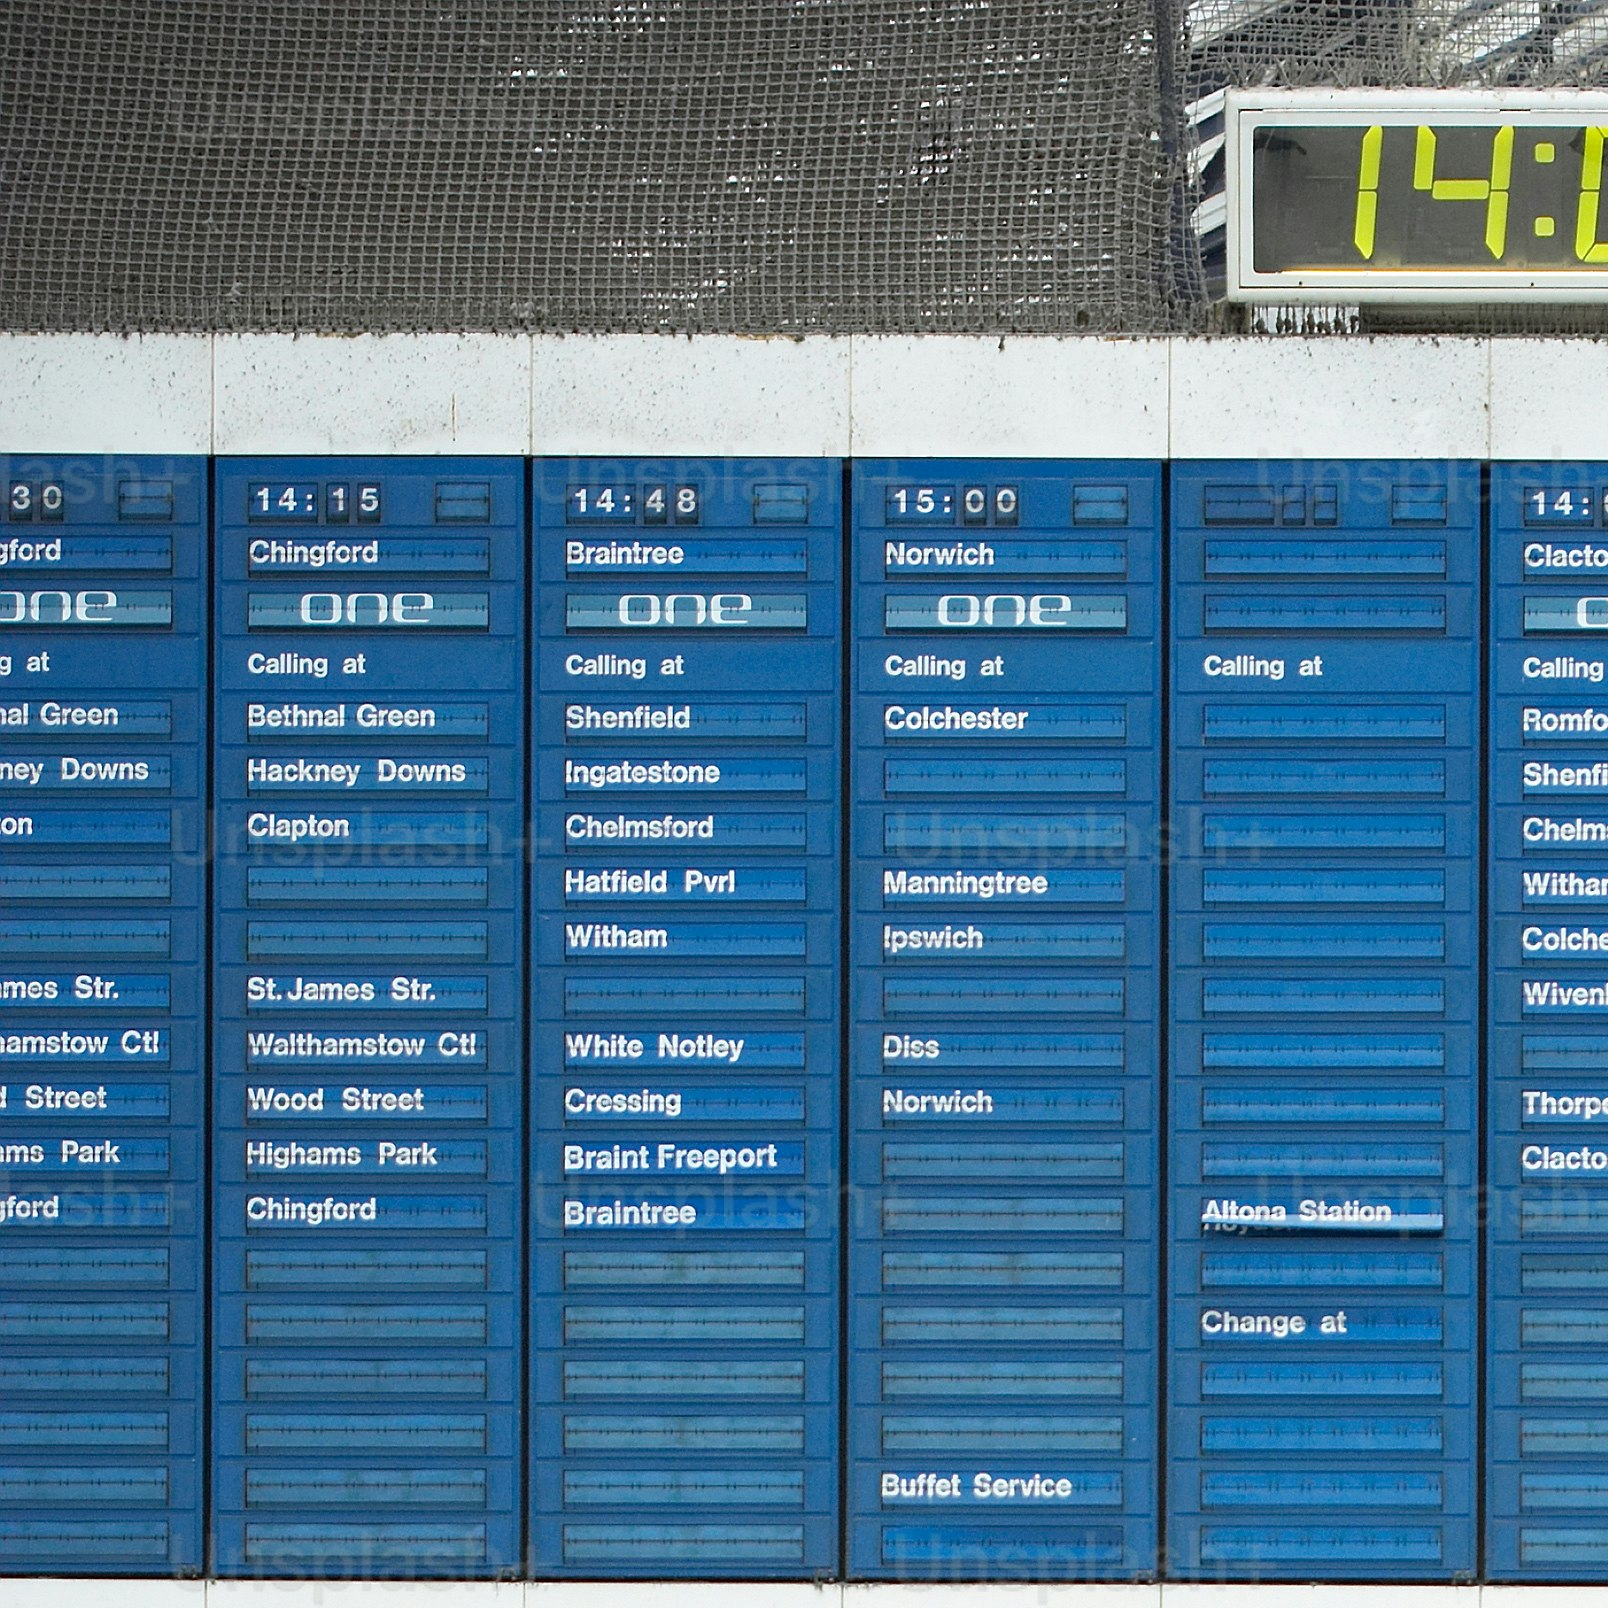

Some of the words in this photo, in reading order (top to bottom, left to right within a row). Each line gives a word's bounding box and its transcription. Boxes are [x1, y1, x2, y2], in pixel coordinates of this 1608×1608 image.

[257, 487, 379, 511] 14:15
[575, 488, 696, 513] 14:48
[894, 489, 1016, 513] 15:00
[249, 540, 378, 567] Chingford
[566, 541, 684, 565] Braintree
[300, 593, 434, 624] one
[247, 653, 328, 678] Calling
[342, 653, 366, 674] at
[248, 704, 345, 727] Bethnal
[356, 703, 435, 727] Green
[248, 758, 361, 787] Hackney
[378, 759, 466, 782] Downs
[565, 760, 720, 788] Ingatestone
[247, 813, 349, 842] Clapton
[565, 814, 714, 838] Chelmsford
[391, 976, 436, 1001] Str.
[248, 1033, 426, 1056] Walthamstow
[438, 1032, 476, 1056] Ctl
[565, 1034, 644, 1058] White
[658, 1034, 744, 1062] Notley
[883, 1035, 940, 1058] Diss
[247, 1142, 361, 1169] Highams
[379, 1142, 438, 1165] Park
[564, 1144, 650, 1170] Braint
[658, 1144, 777, 1174] Freeport
[1202, 1199, 1287, 1222] Altona
[1298, 1199, 1393, 1222] Station
[1201, 1310, 1306, 1338] Change
[1320, 1311, 1347, 1333] at
[881, 1473, 961, 1498] Buffet
[973, 1472, 1072, 1498] Service
